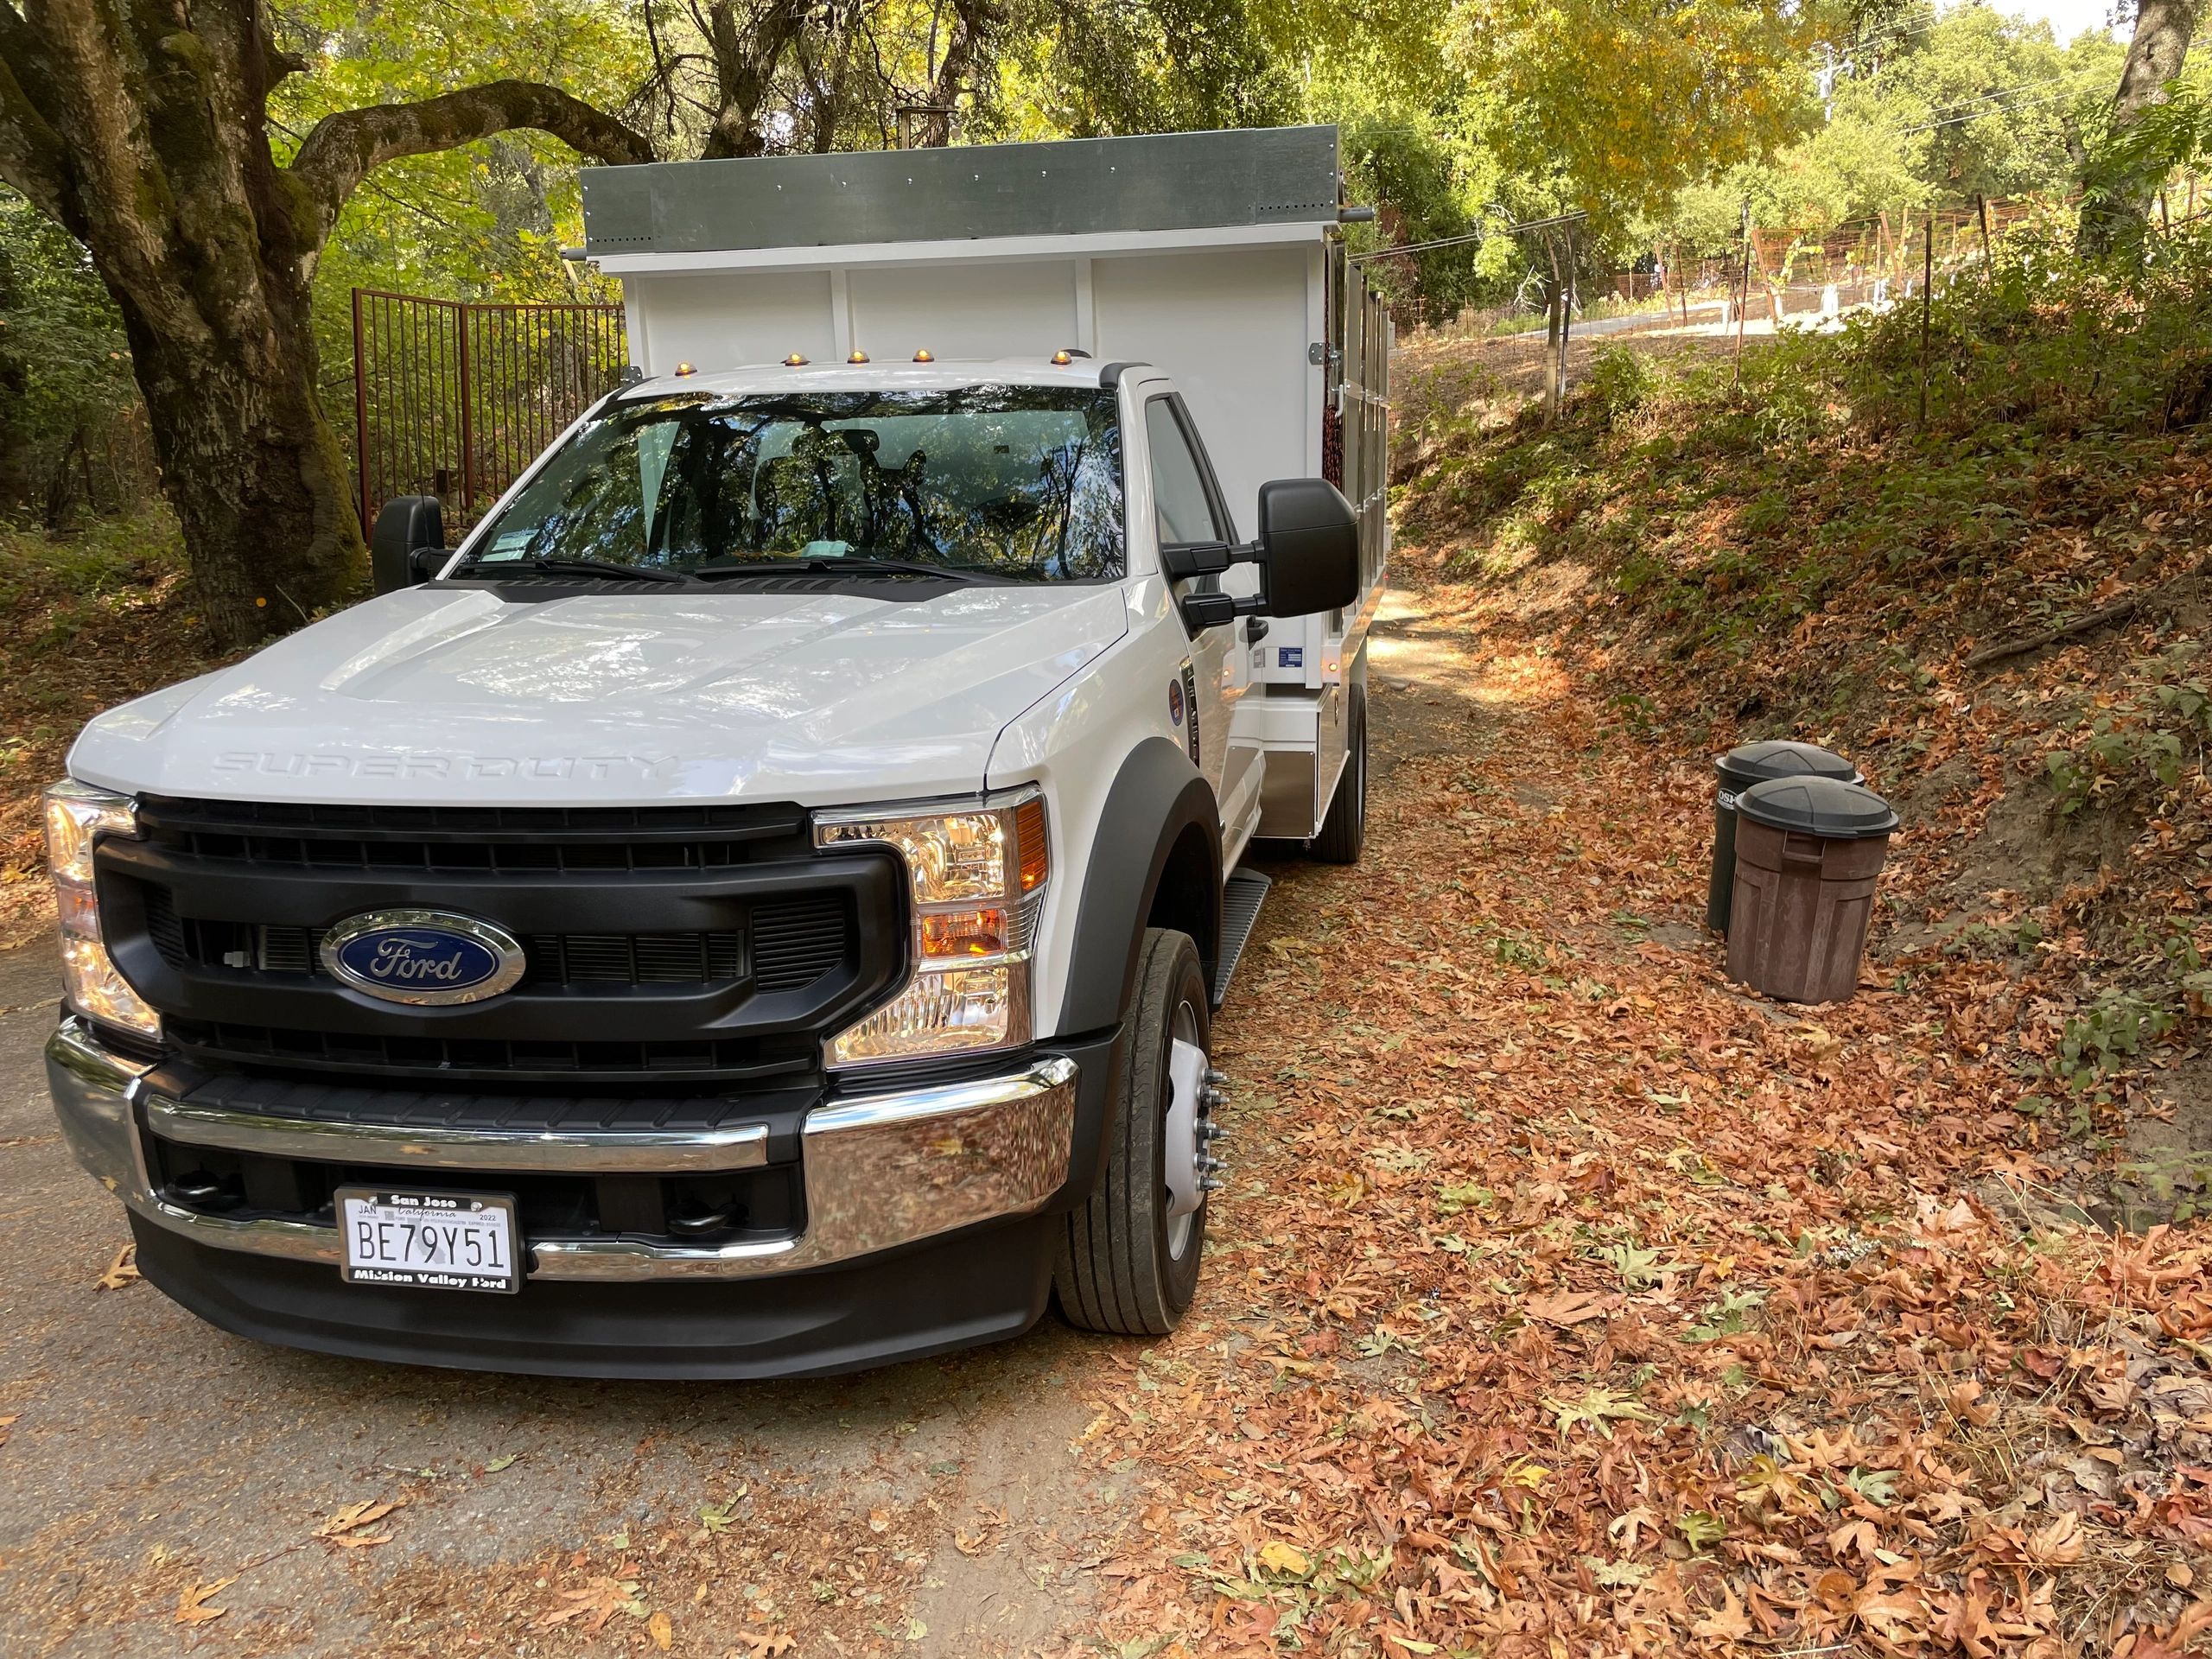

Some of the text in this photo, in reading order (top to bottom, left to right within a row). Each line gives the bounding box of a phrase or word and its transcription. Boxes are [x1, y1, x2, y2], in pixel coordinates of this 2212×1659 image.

[211, 751, 679, 780] SUPER DUTY
[370, 938, 463, 981] Ford
[391, 1194, 457, 1208] San Jose
[358, 1205, 377, 1215] JAN
[397, 1207, 457, 1221] California
[357, 1221, 505, 1268] BE79Y51
[417, 1273, 467, 1288] Valley
